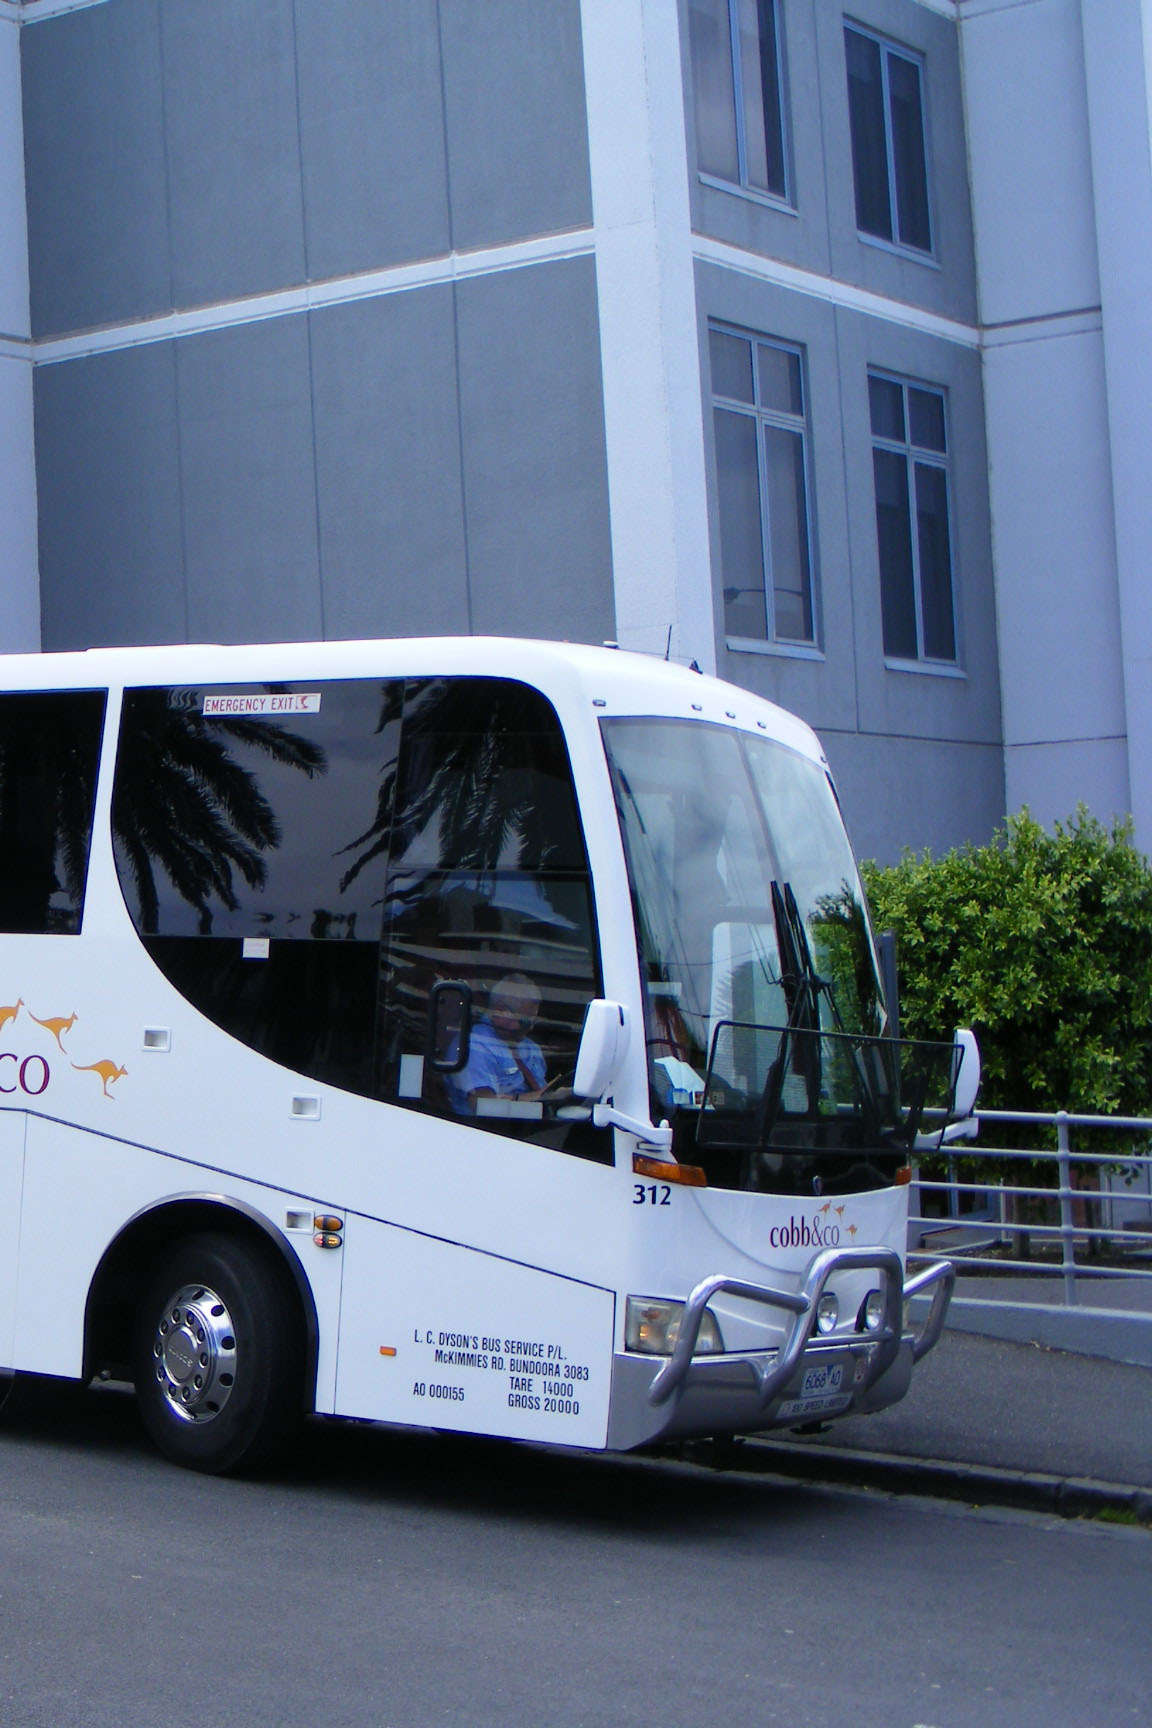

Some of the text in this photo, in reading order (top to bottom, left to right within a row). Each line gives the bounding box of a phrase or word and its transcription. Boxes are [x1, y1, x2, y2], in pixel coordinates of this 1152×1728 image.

[205, 697, 294, 712] EMERGENCY EXIT
[633, 1184, 671, 1205] 312
[769, 1215, 840, 1248] cobb&co
[414, 1329, 567, 1360] L. C. DYSON'S BUS SERVICE P/L.
[434, 1349, 589, 1381] McKIMMIES RD. BUNDOORA 3083
[429, 1384, 465, 1401] 000155
[509, 1376, 574, 1397] TARE 14000
[508, 1393, 580, 1415] GROSS 20000
